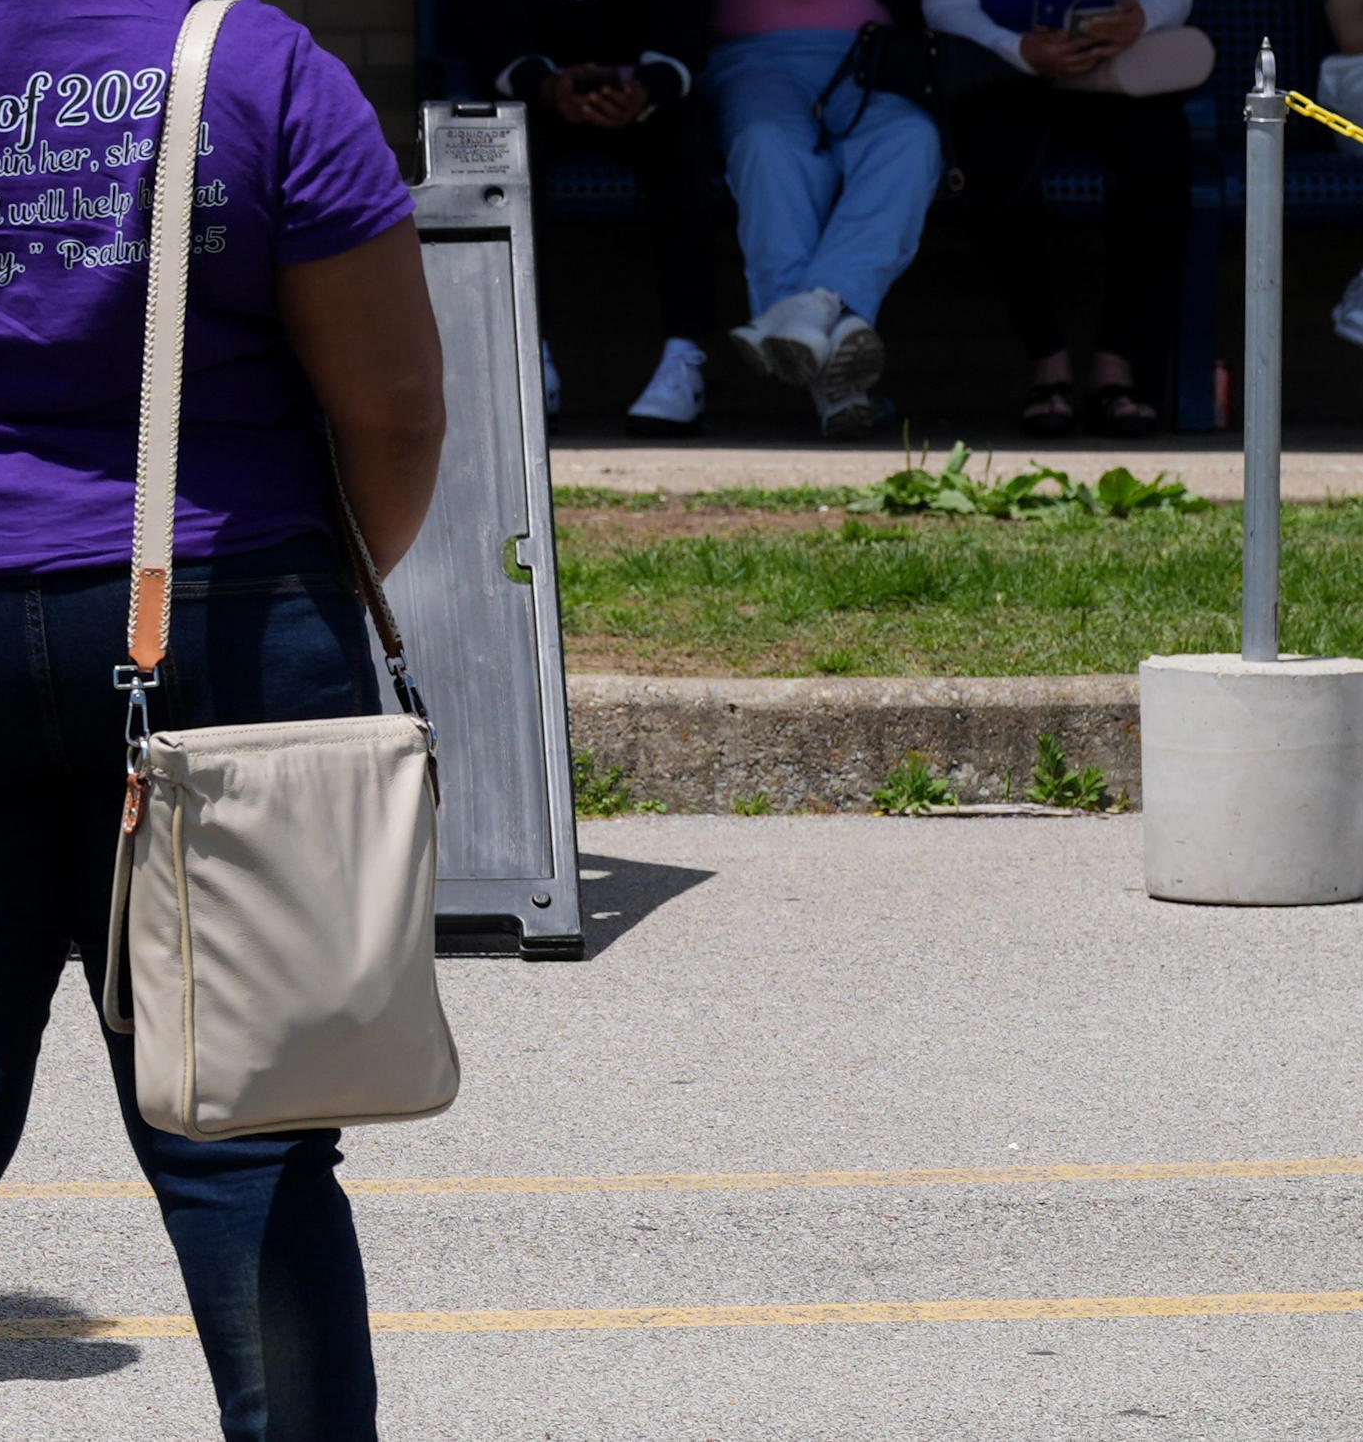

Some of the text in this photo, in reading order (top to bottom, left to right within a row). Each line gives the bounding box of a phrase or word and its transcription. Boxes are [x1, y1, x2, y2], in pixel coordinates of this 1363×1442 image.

[56, 68, 166, 127] 202
[40, 140, 100, 172] her,
[105, 131, 158, 167] she
[8, 188, 69, 225] will
[74, 182, 134, 227] help
[192, 179, 229, 208] at
[192, 225, 228, 255] :5
